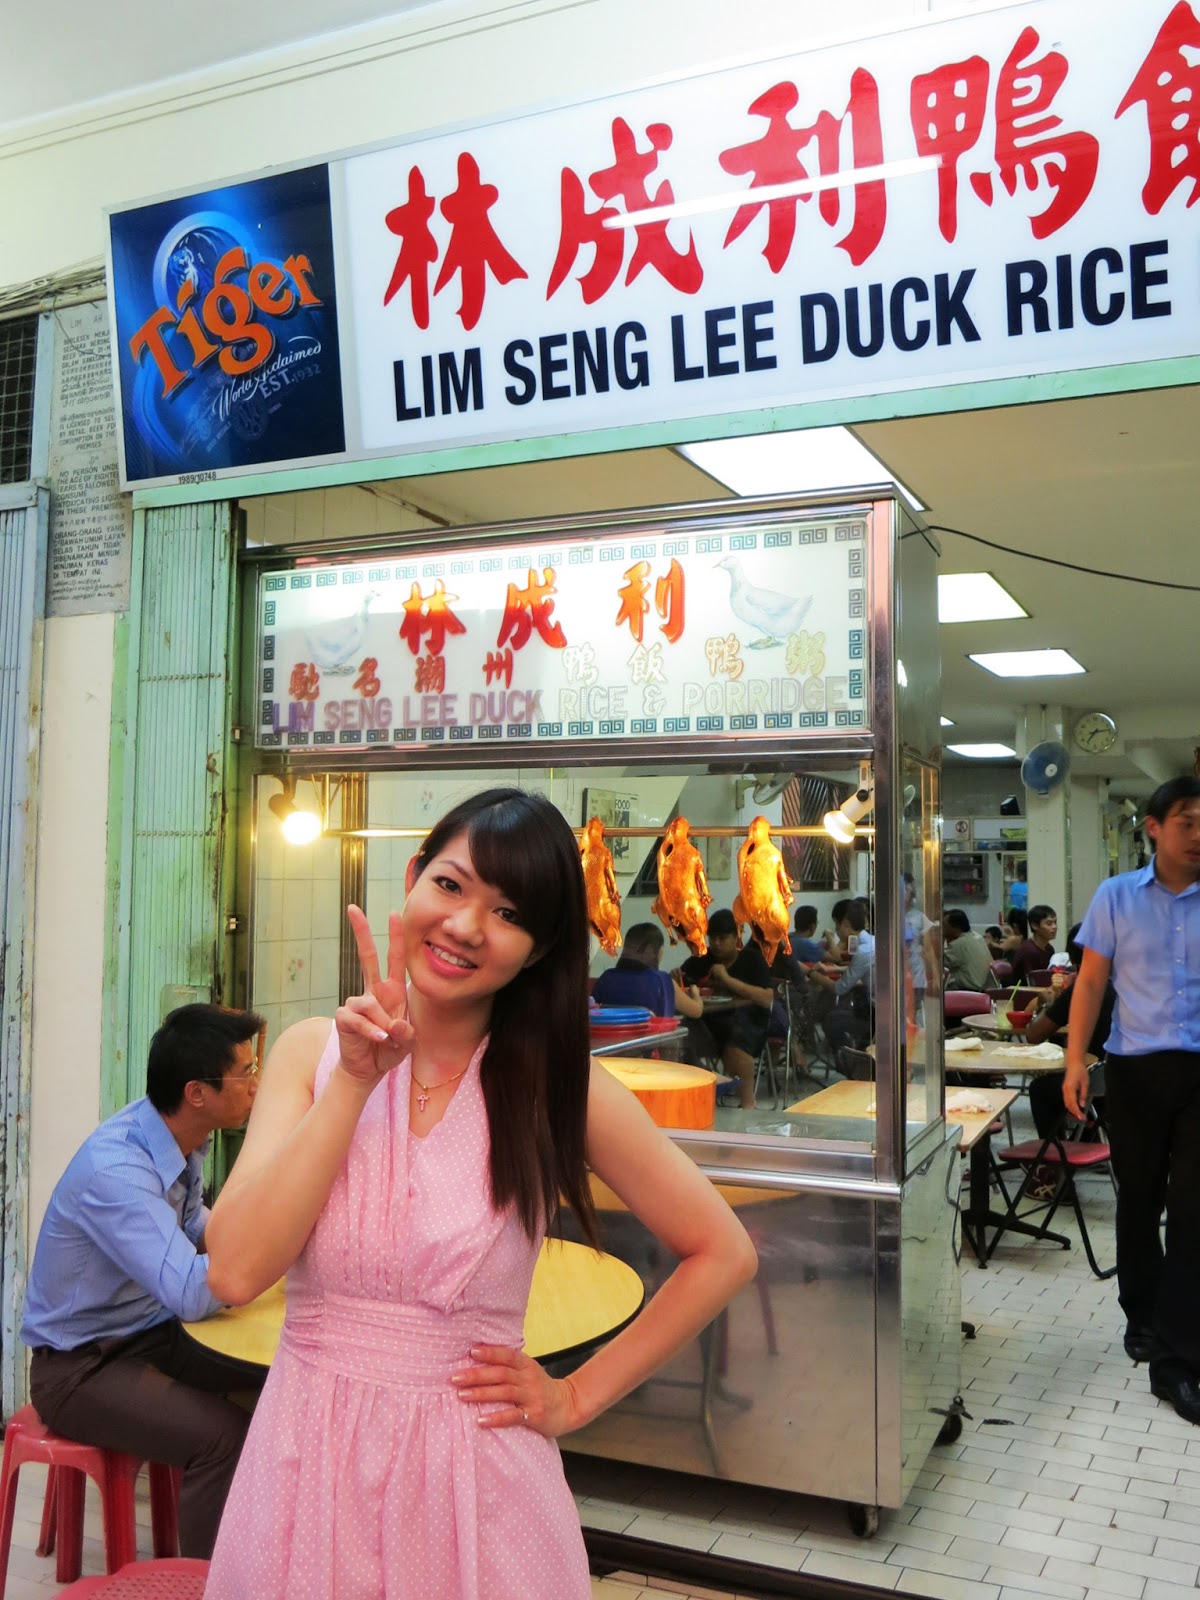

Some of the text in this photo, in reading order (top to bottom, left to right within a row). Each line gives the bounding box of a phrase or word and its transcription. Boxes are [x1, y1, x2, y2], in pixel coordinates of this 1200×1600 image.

[129, 247, 324, 399] Tiger
[393, 239, 1172, 422] LIM SENG LEE DUCK RICE
[72, 466, 98, 476] PERSON
[70, 475, 82, 483] AGE
[178, 471, 217, 485] 1989/10748
[85, 479, 116, 489] ALLOWED
[56, 490, 88, 500] CONSUME
[56, 496, 100, 508] INTOXICATING
[67, 507, 87, 515] THESE
[107, 523, 124, 533] YANG
[84, 535, 103, 543] UMUR
[53, 541, 121, 555] BELAS TAHUN TIDAK
[98, 549, 120, 558] MINUM
[53, 559, 108, 570] MINUMAN KERAS
[62, 569, 88, 578] TEMPAT
[399, 557, 685, 656] 林成利
[272, 676, 848, 734] LIM SENG LEE DUCK RICE & PORRIDGE
